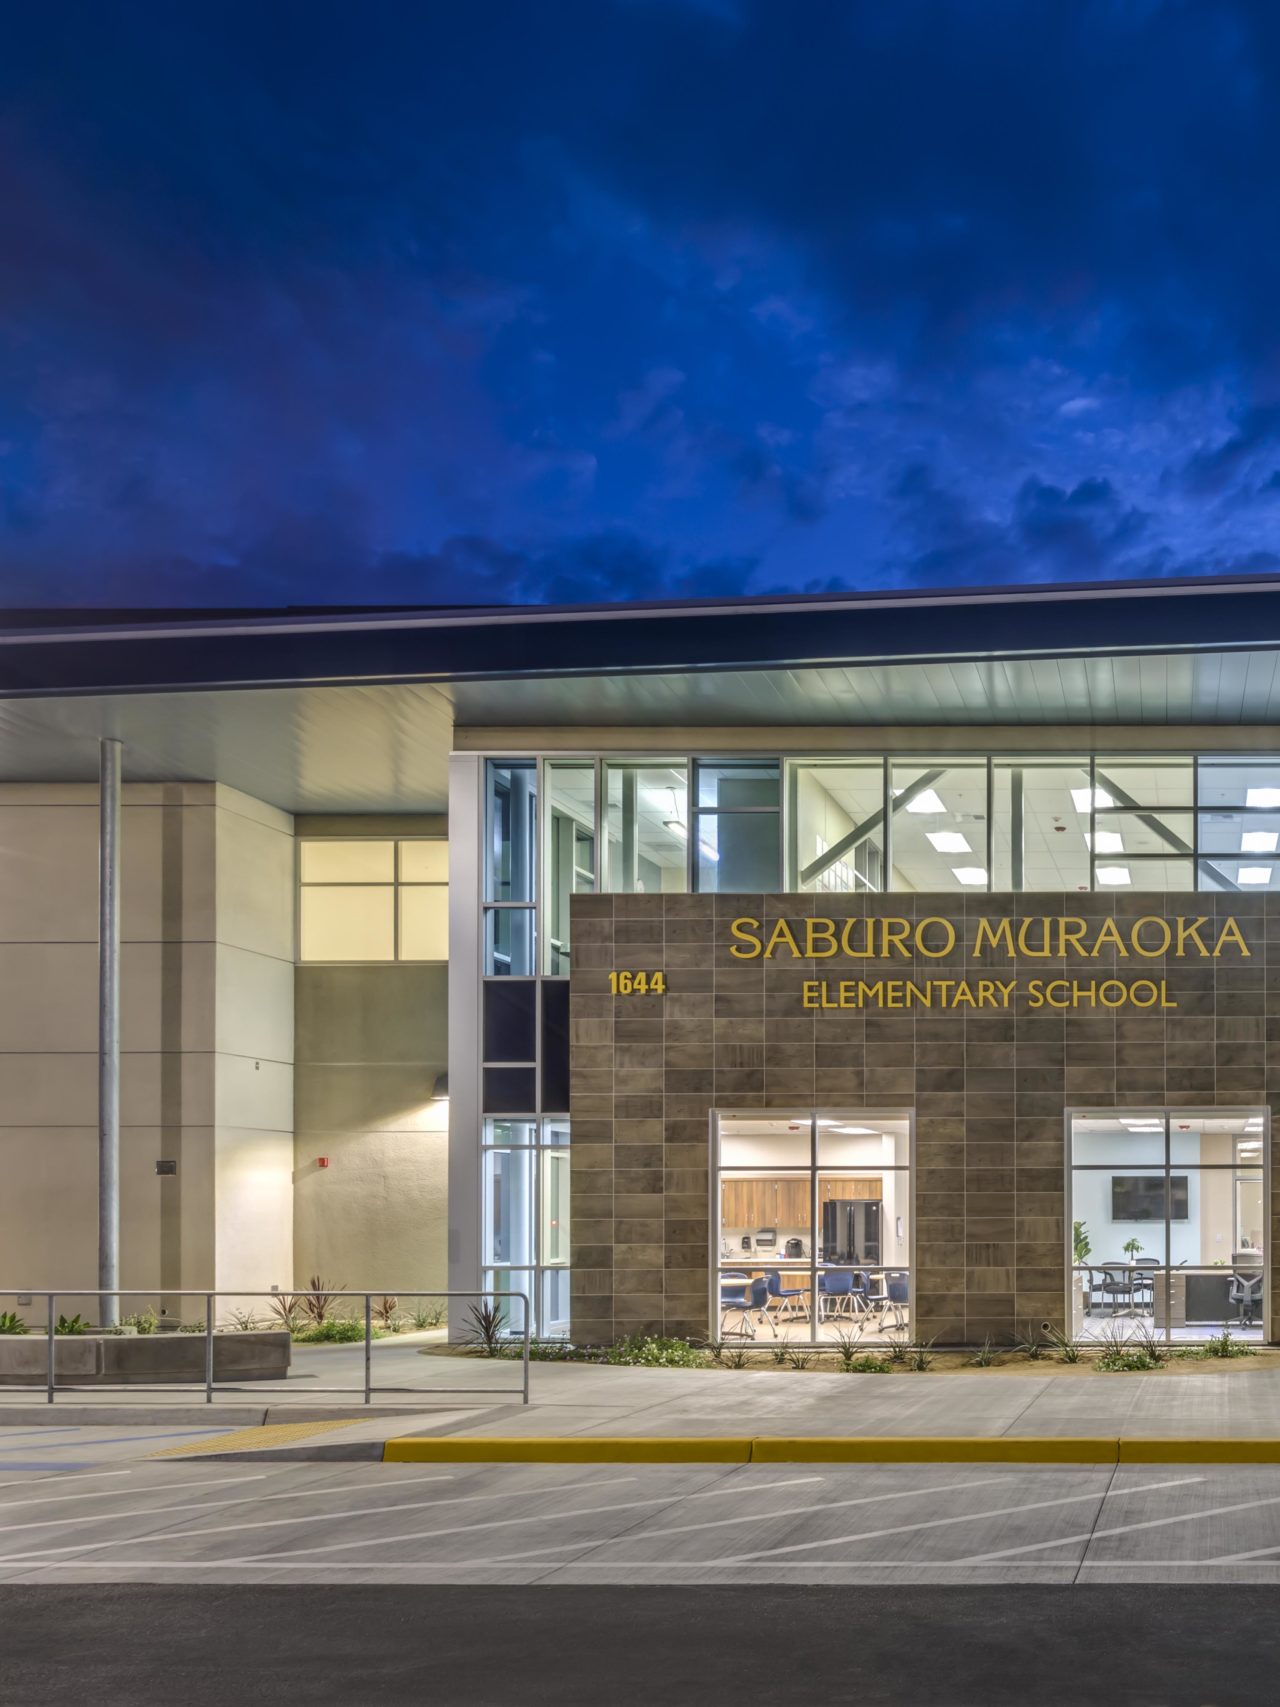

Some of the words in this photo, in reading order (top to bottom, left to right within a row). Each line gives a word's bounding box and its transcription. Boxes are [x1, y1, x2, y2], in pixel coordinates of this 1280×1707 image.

[730, 916, 955, 959] SABURO
[972, 916, 1251, 957] MURAOKA
[608, 971, 665, 994] 1644
[803, 980, 1017, 1008] ELEMENTARY
[1028, 979, 1177, 1007] SCHOOL
